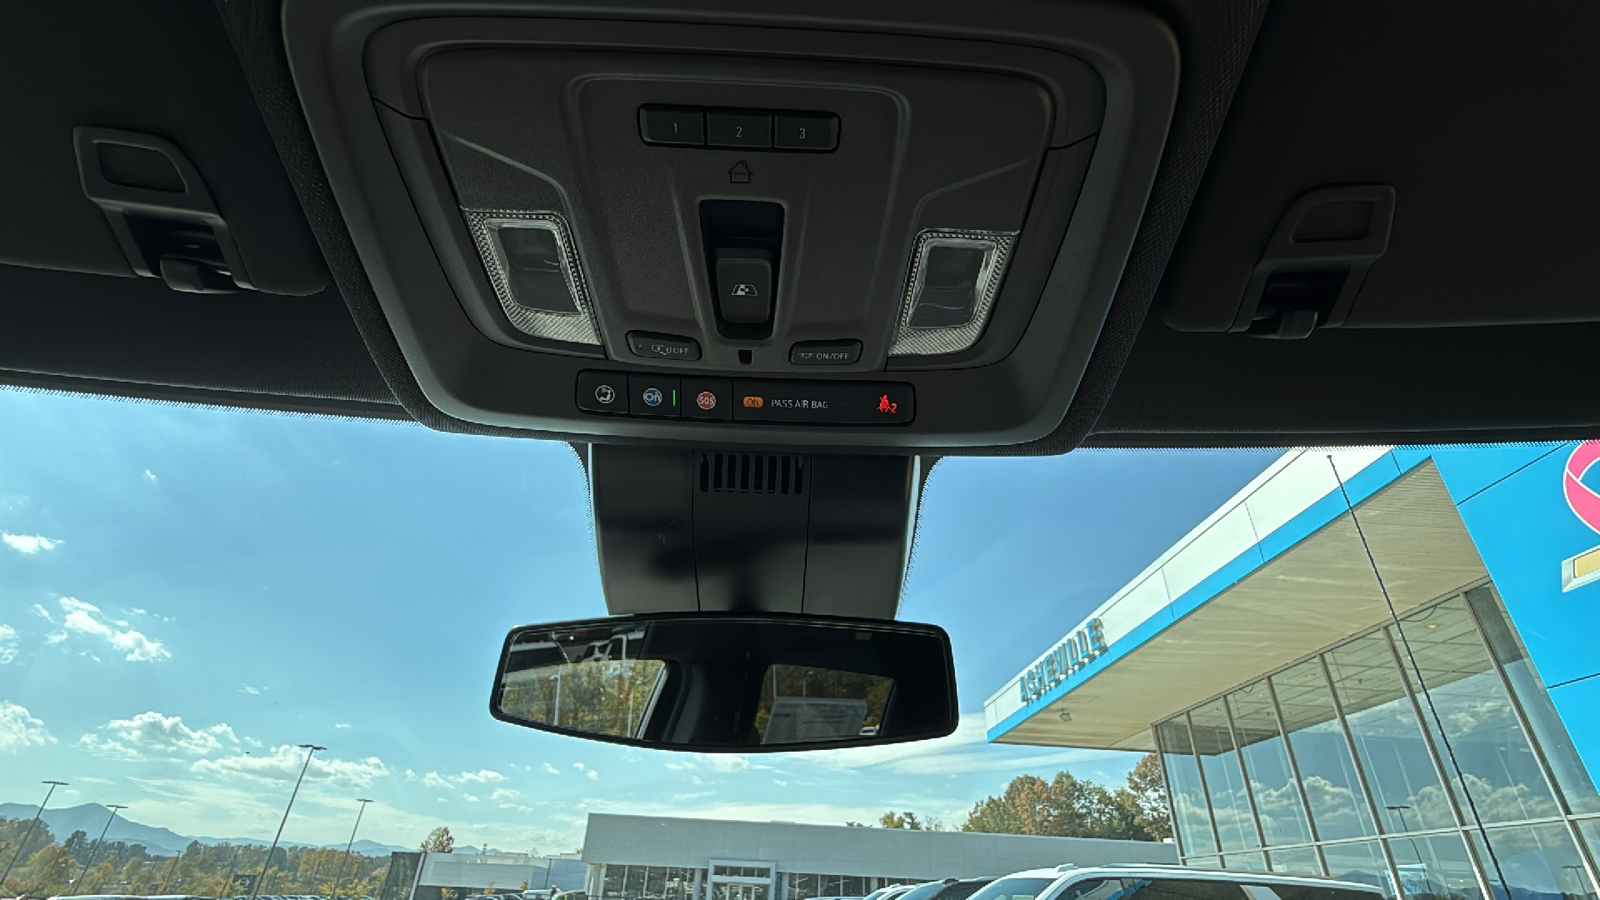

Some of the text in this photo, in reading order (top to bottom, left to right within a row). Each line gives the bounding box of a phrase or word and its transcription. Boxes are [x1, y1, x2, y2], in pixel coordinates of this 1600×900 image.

[672, 122, 806, 139] 1 2 3
[672, 346, 690, 355] OFF
[816, 352, 850, 360] ON/OFF
[699, 396, 714, 405] SOS
[746, 397, 760, 407] ON
[771, 399, 829, 409] PASS AIR BAG
[1020, 617, 1107, 704] ASHEVILLE
